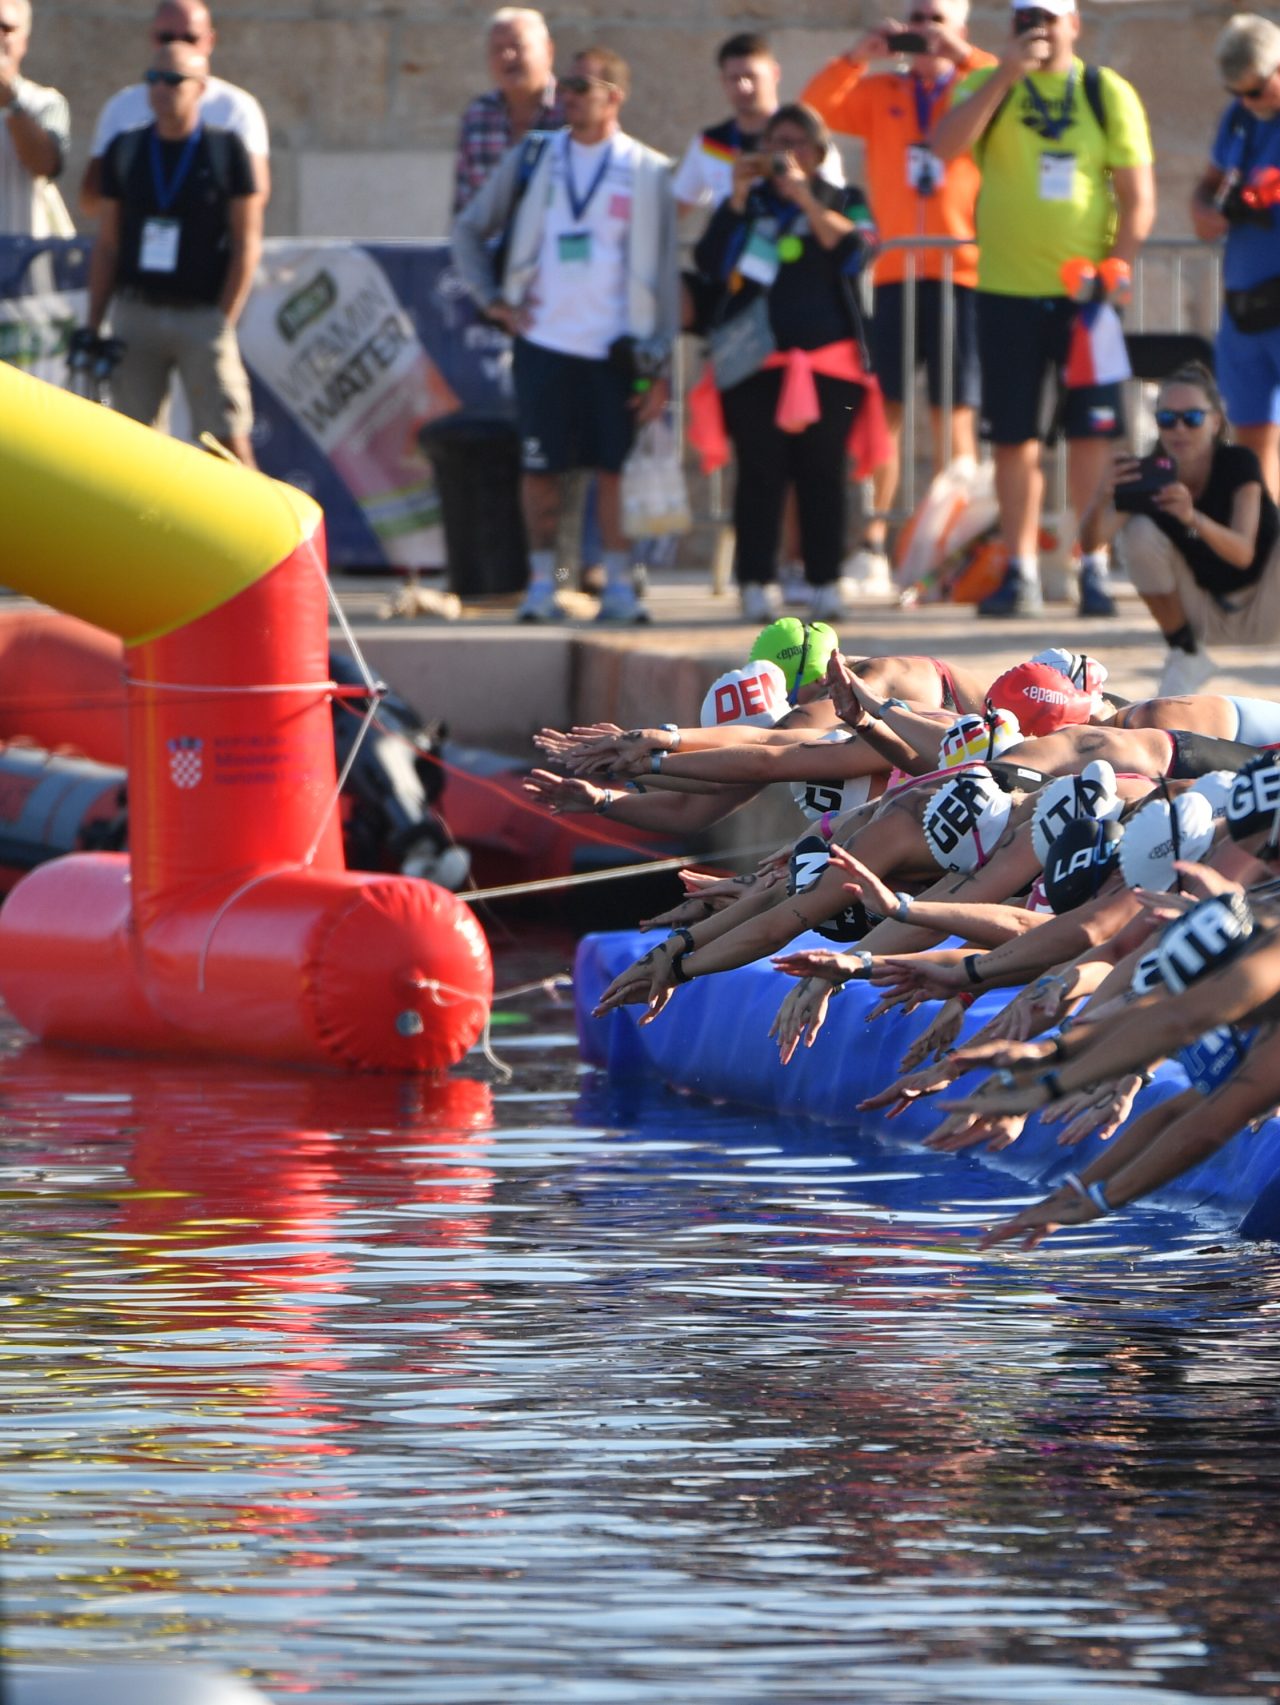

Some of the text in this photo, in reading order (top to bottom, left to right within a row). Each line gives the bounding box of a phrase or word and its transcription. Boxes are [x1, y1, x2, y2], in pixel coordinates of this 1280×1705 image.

[301, 313, 407, 434] WATER
[928, 780, 990, 854] GER
[1039, 779, 1109, 846] ITA
[1160, 899, 1241, 995] ITA
